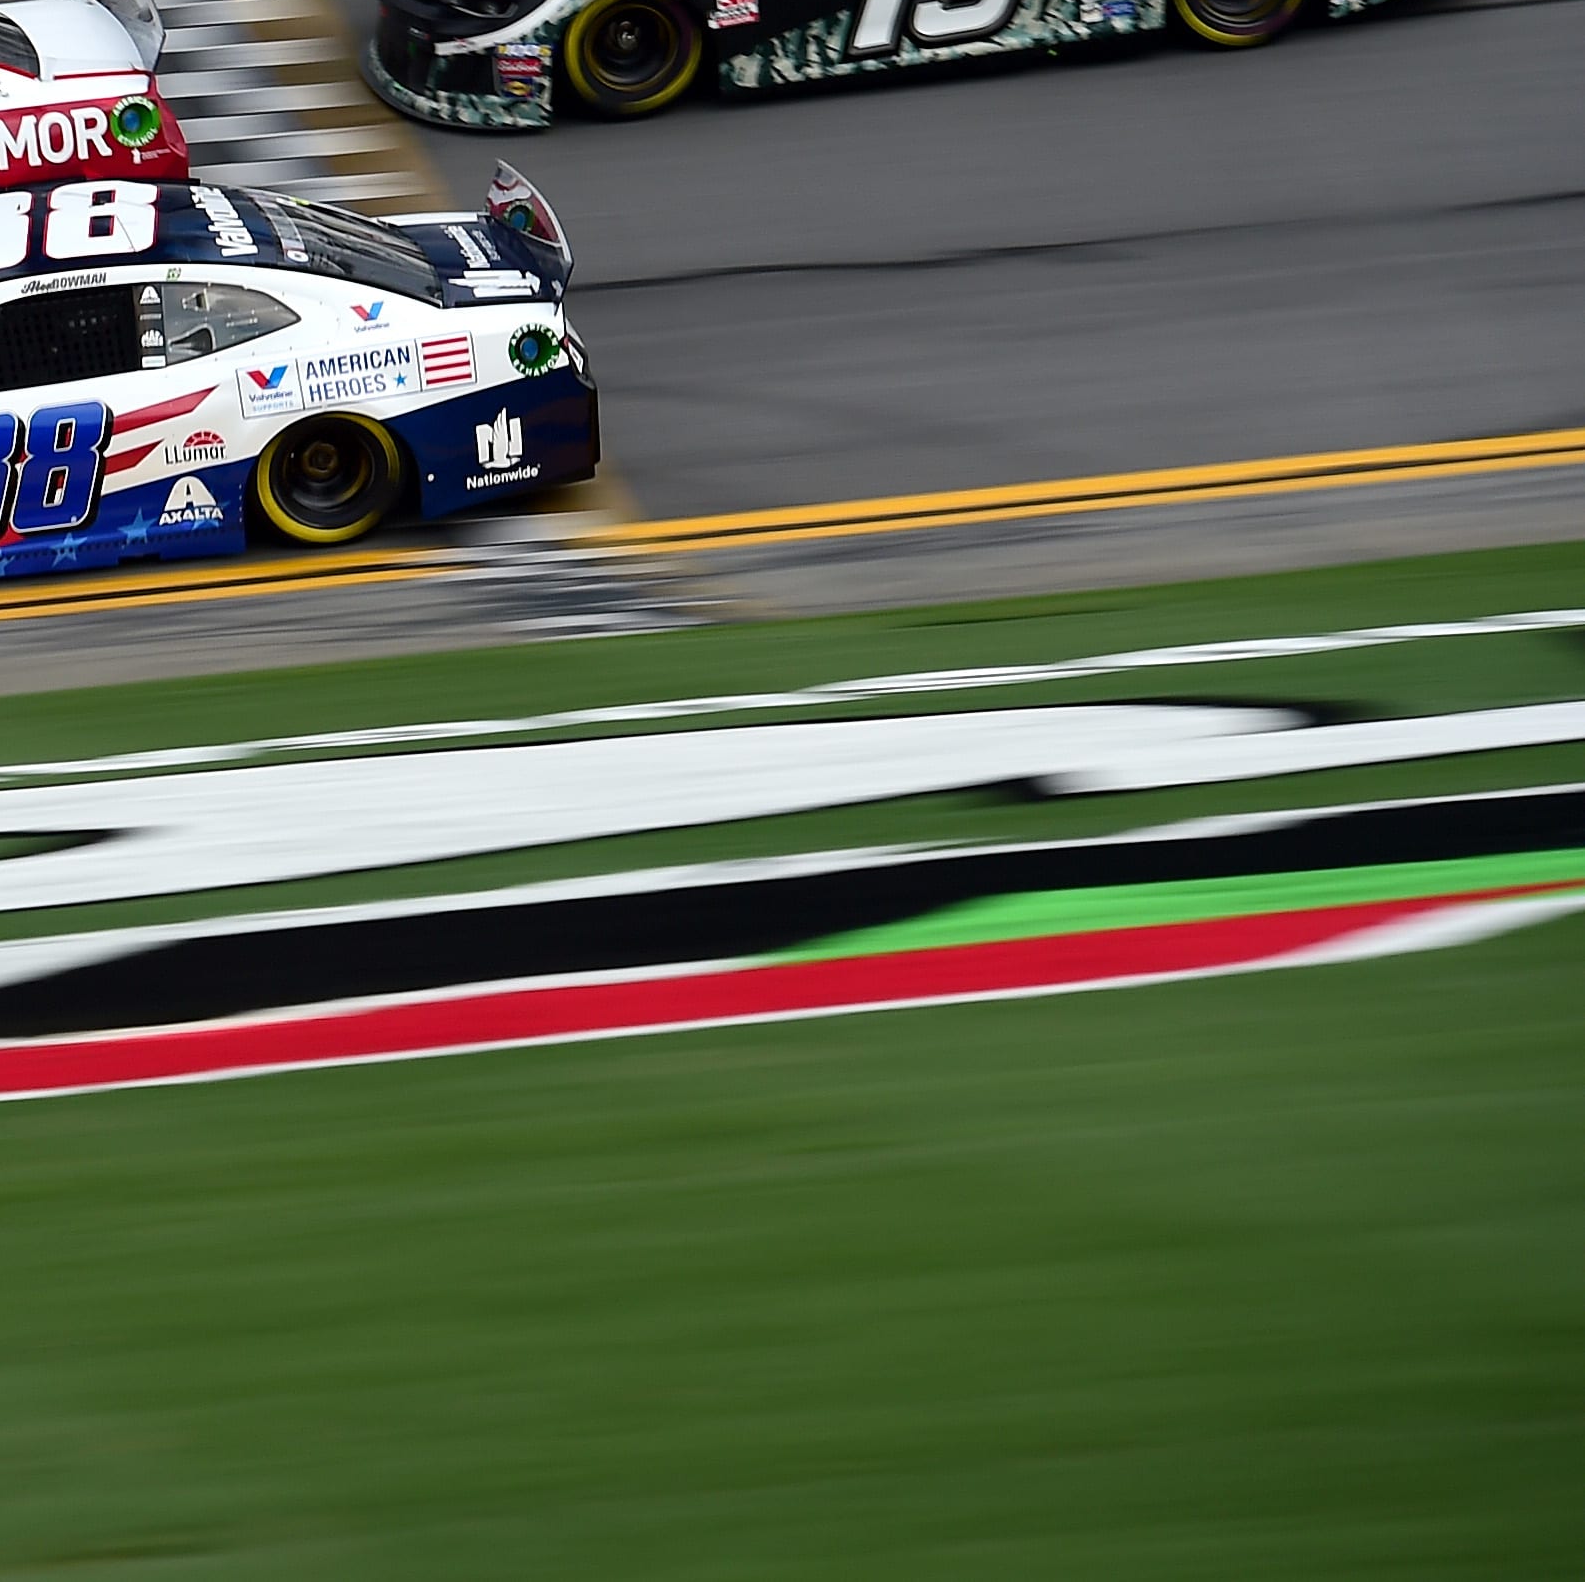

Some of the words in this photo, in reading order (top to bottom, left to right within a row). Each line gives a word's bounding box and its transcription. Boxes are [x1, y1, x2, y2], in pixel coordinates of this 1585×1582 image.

[53, 273, 107, 290] BOWMAN
[511, 323, 559, 346] AMERICAN
[306, 345, 411, 380] AMERICAN
[513, 354, 558, 377] ETHANOL
[249, 390, 294, 403] Valvoline
[309, 374, 387, 403] HEROES
[466, 463, 541, 491] Nationwide
[159, 506, 223, 526] AXALTA
